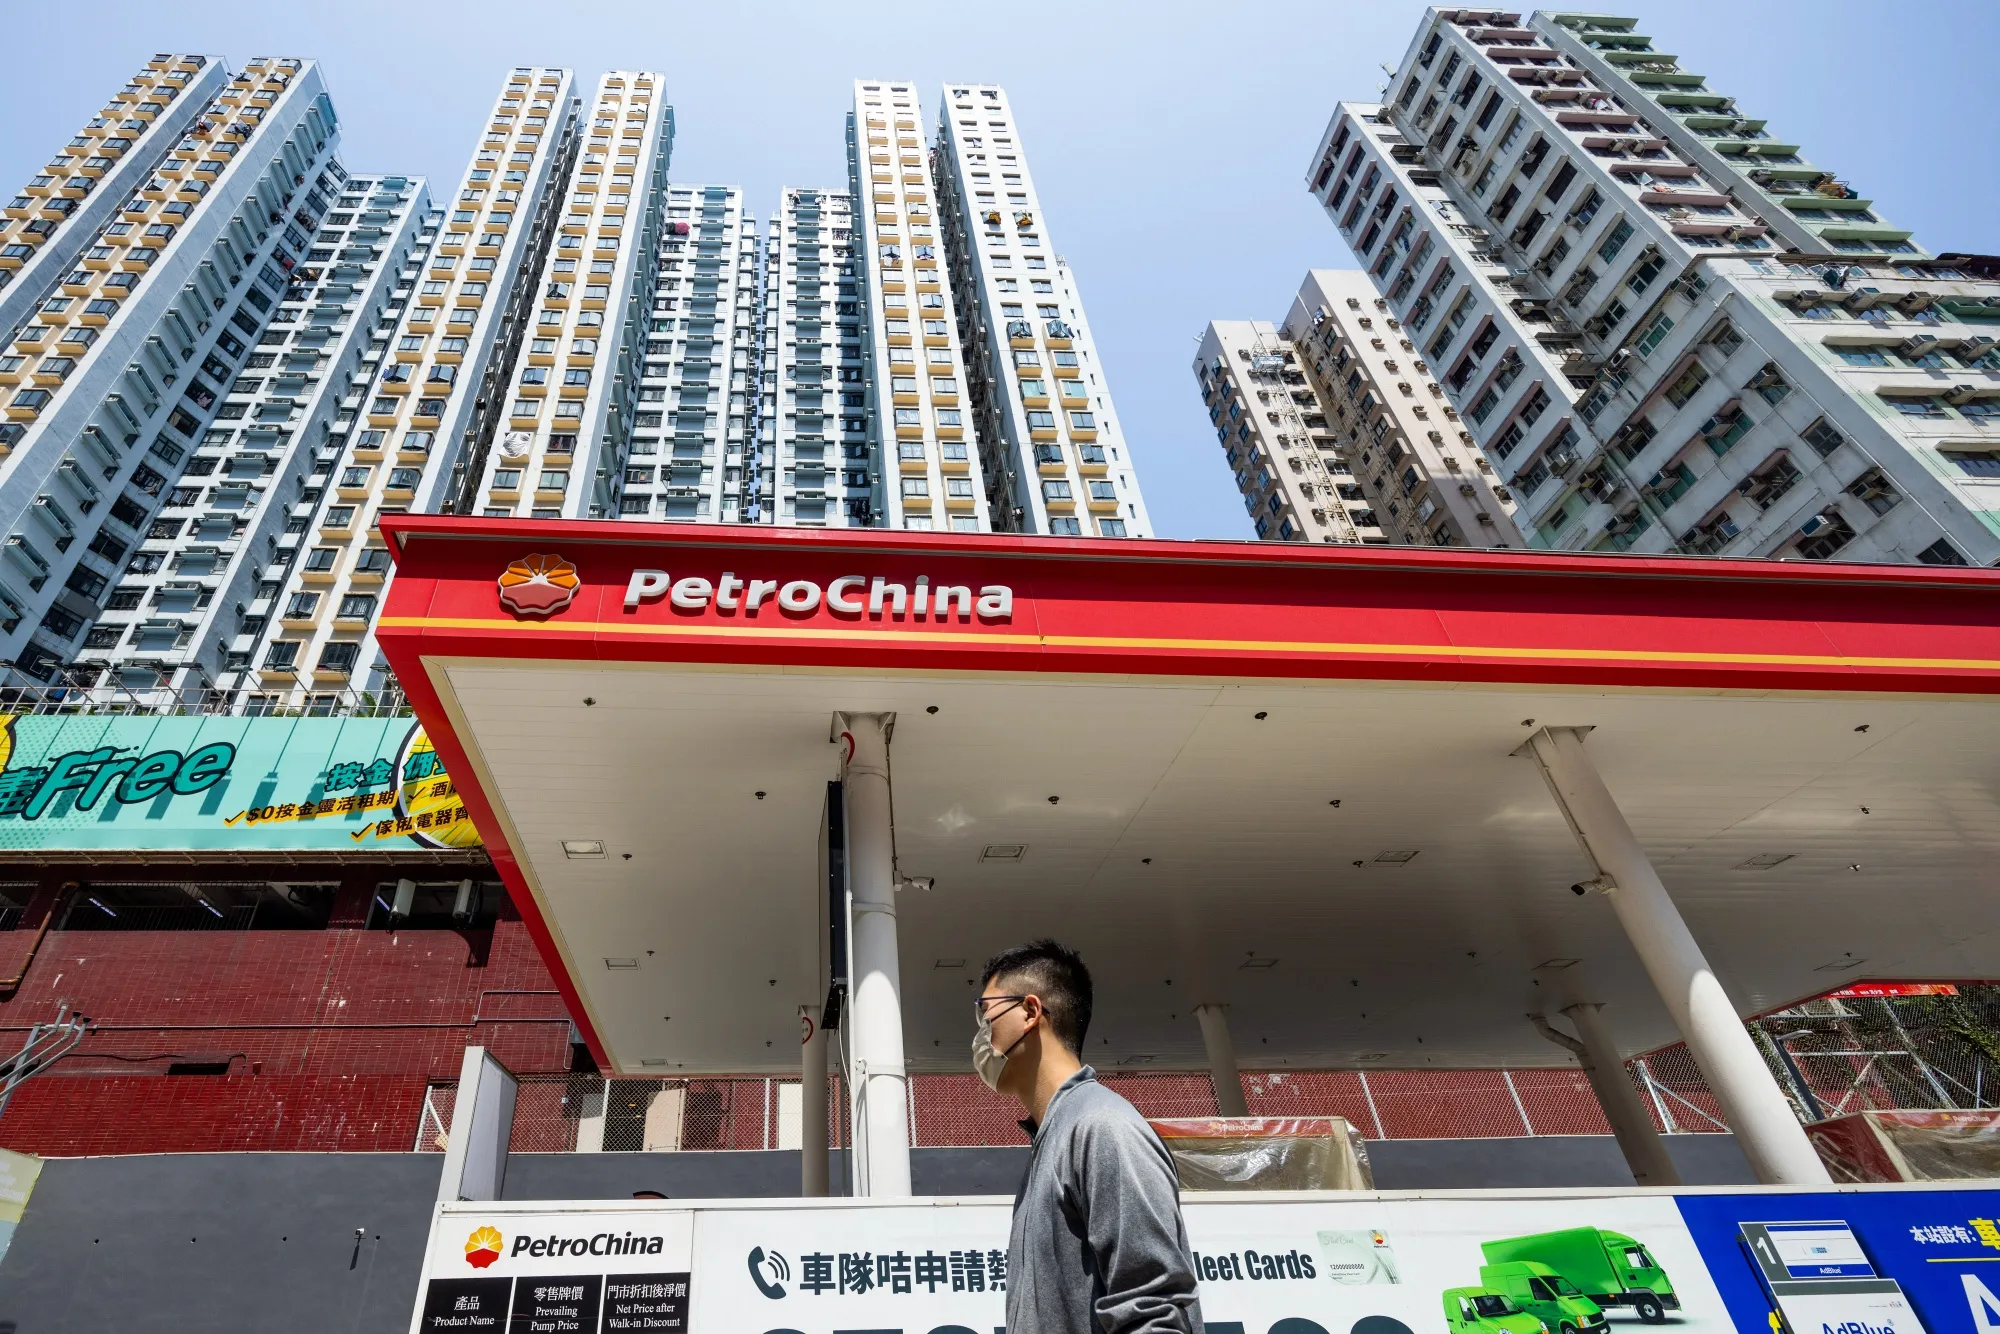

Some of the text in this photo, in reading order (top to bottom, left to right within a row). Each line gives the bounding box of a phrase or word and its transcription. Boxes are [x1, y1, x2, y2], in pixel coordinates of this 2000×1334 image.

[623, 569, 1013, 617] PetroChina
[324, 758, 394, 792] 按金
[430, 781, 456, 797] 酒
[246, 791, 395, 822] $0按金靈活租期
[1224, 1123, 1264, 1132] PetroChina
[1967, 1217, 2000, 1250] 車
[511, 1231, 664, 1257] PetroChina
[1756, 1236, 1777, 1265] 1
[1192, 1249, 1317, 1281] leet Cards
[534, 1286, 584, 1302] 零售牌價
[607, 1283, 686, 1300] 門市折扣後淨價
[454, 1296, 480, 1311] 產品
[616, 1302, 675, 1314] Net Price after
[535, 1306, 578, 1319] Prevailing
[434, 1316, 495, 1328] Product Name
[531, 1320, 579, 1334] Pump Price
[609, 1317, 681, 1329] Walk-in Discount
